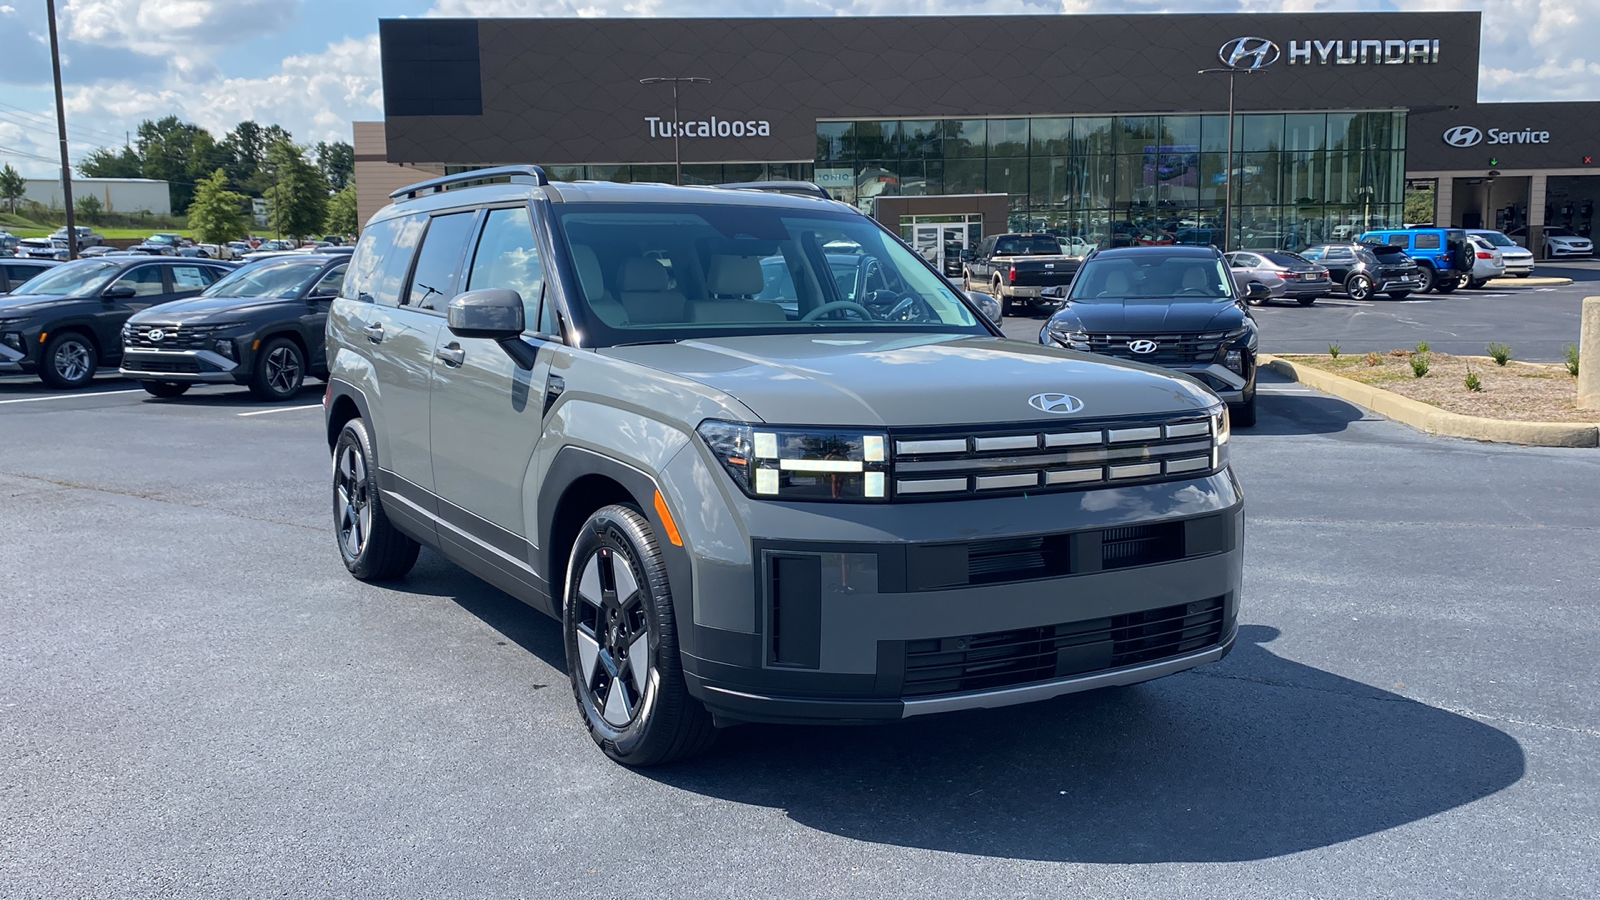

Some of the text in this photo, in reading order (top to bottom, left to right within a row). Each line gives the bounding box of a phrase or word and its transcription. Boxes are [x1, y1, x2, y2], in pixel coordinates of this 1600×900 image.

[1289, 39, 1440, 65] HYUNDAI
[644, 116, 770, 138] Tuscaloosa
[1487, 127, 1550, 145] Service
